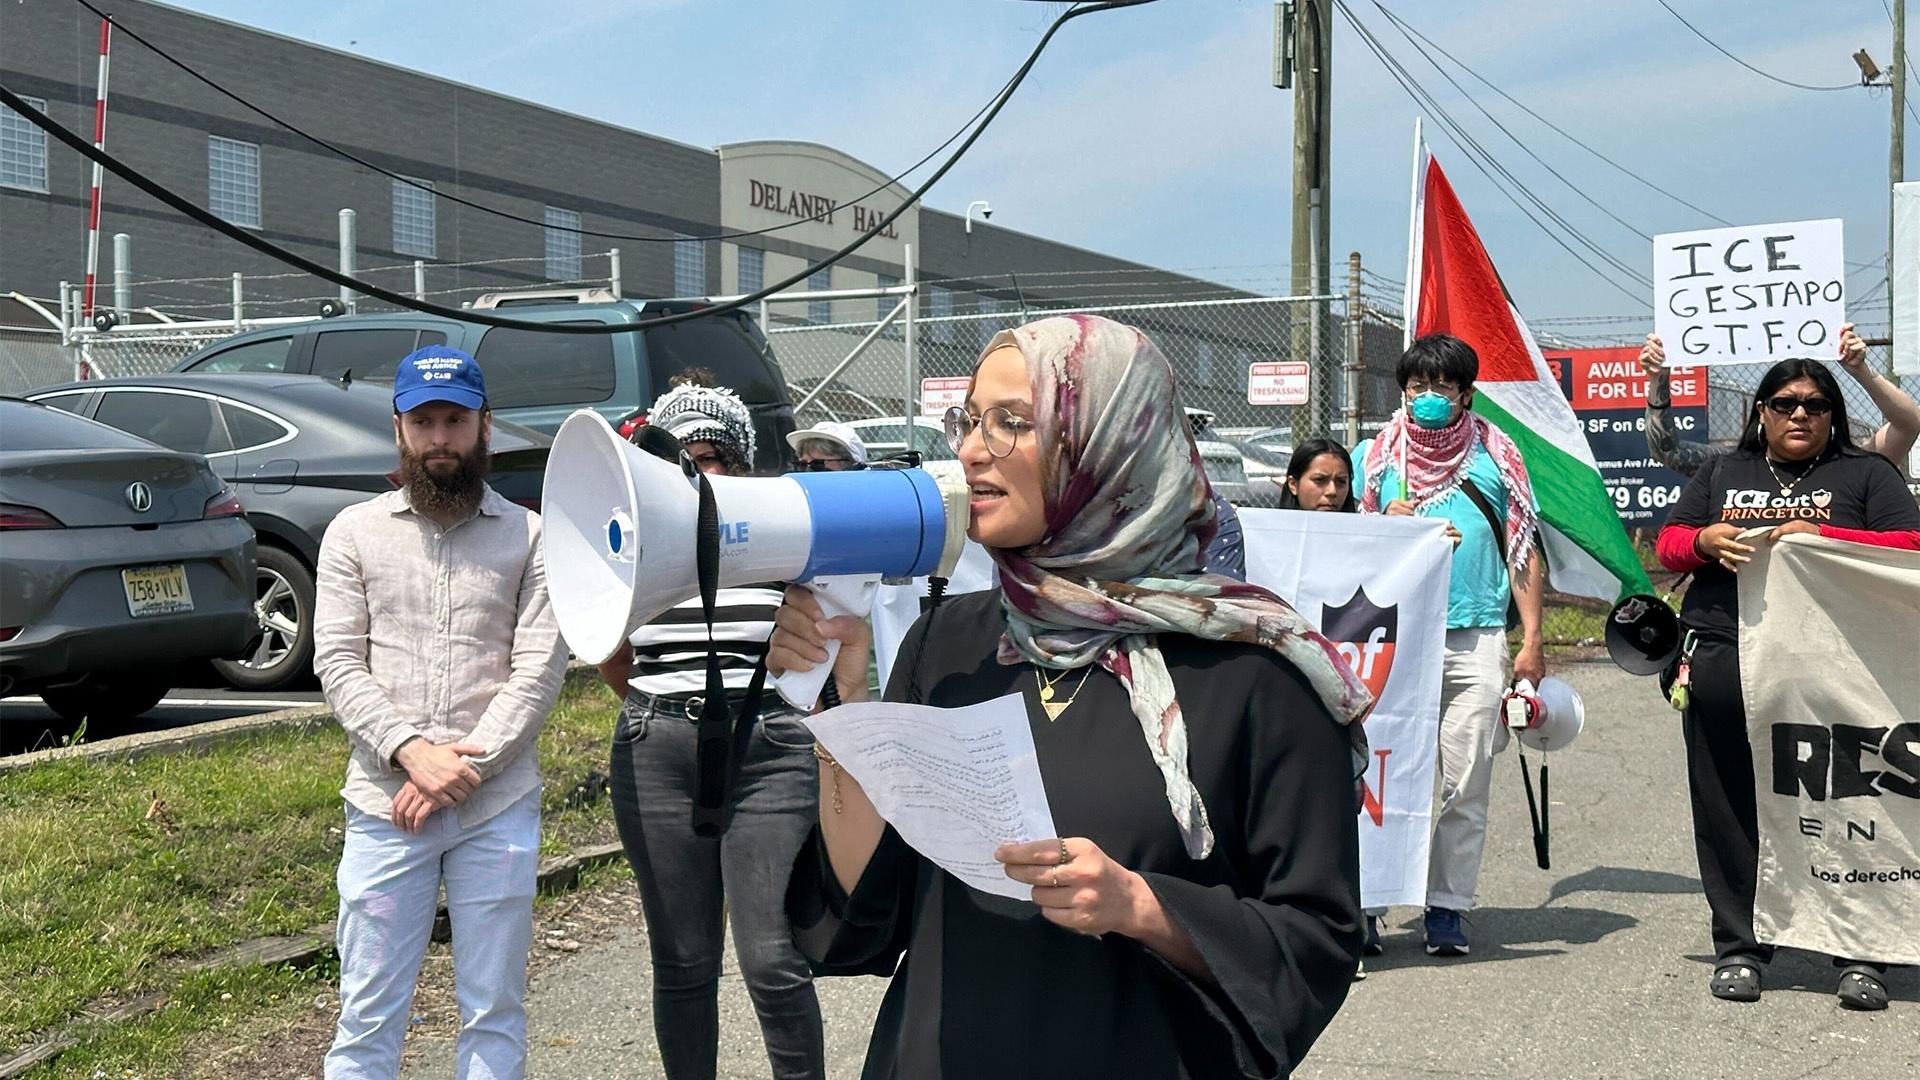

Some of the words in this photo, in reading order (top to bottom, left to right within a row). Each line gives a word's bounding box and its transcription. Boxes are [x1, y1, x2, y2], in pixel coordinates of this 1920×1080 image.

[749, 179, 837, 225] DELANEY
[853, 205, 899, 240] HALL
[1669, 235, 1802, 280] ICE
[1669, 280, 1843, 317] GESTAPO
[1588, 361, 1694, 378] AVAILLE
[1253, 387, 1305, 395] TRESPASSING
[1588, 383, 1626, 399] FOR
[1632, 379, 1696, 397] LSE
[1588, 419, 1608, 432] SF
[1613, 419, 1631, 431] on
[1624, 460, 1640, 468] Ave
[1723, 489, 1770, 509] ICE
[1771, 494, 1810, 508] out
[1721, 508, 1831, 521] PRINCETON
[1811, 866, 1840, 884] Los
